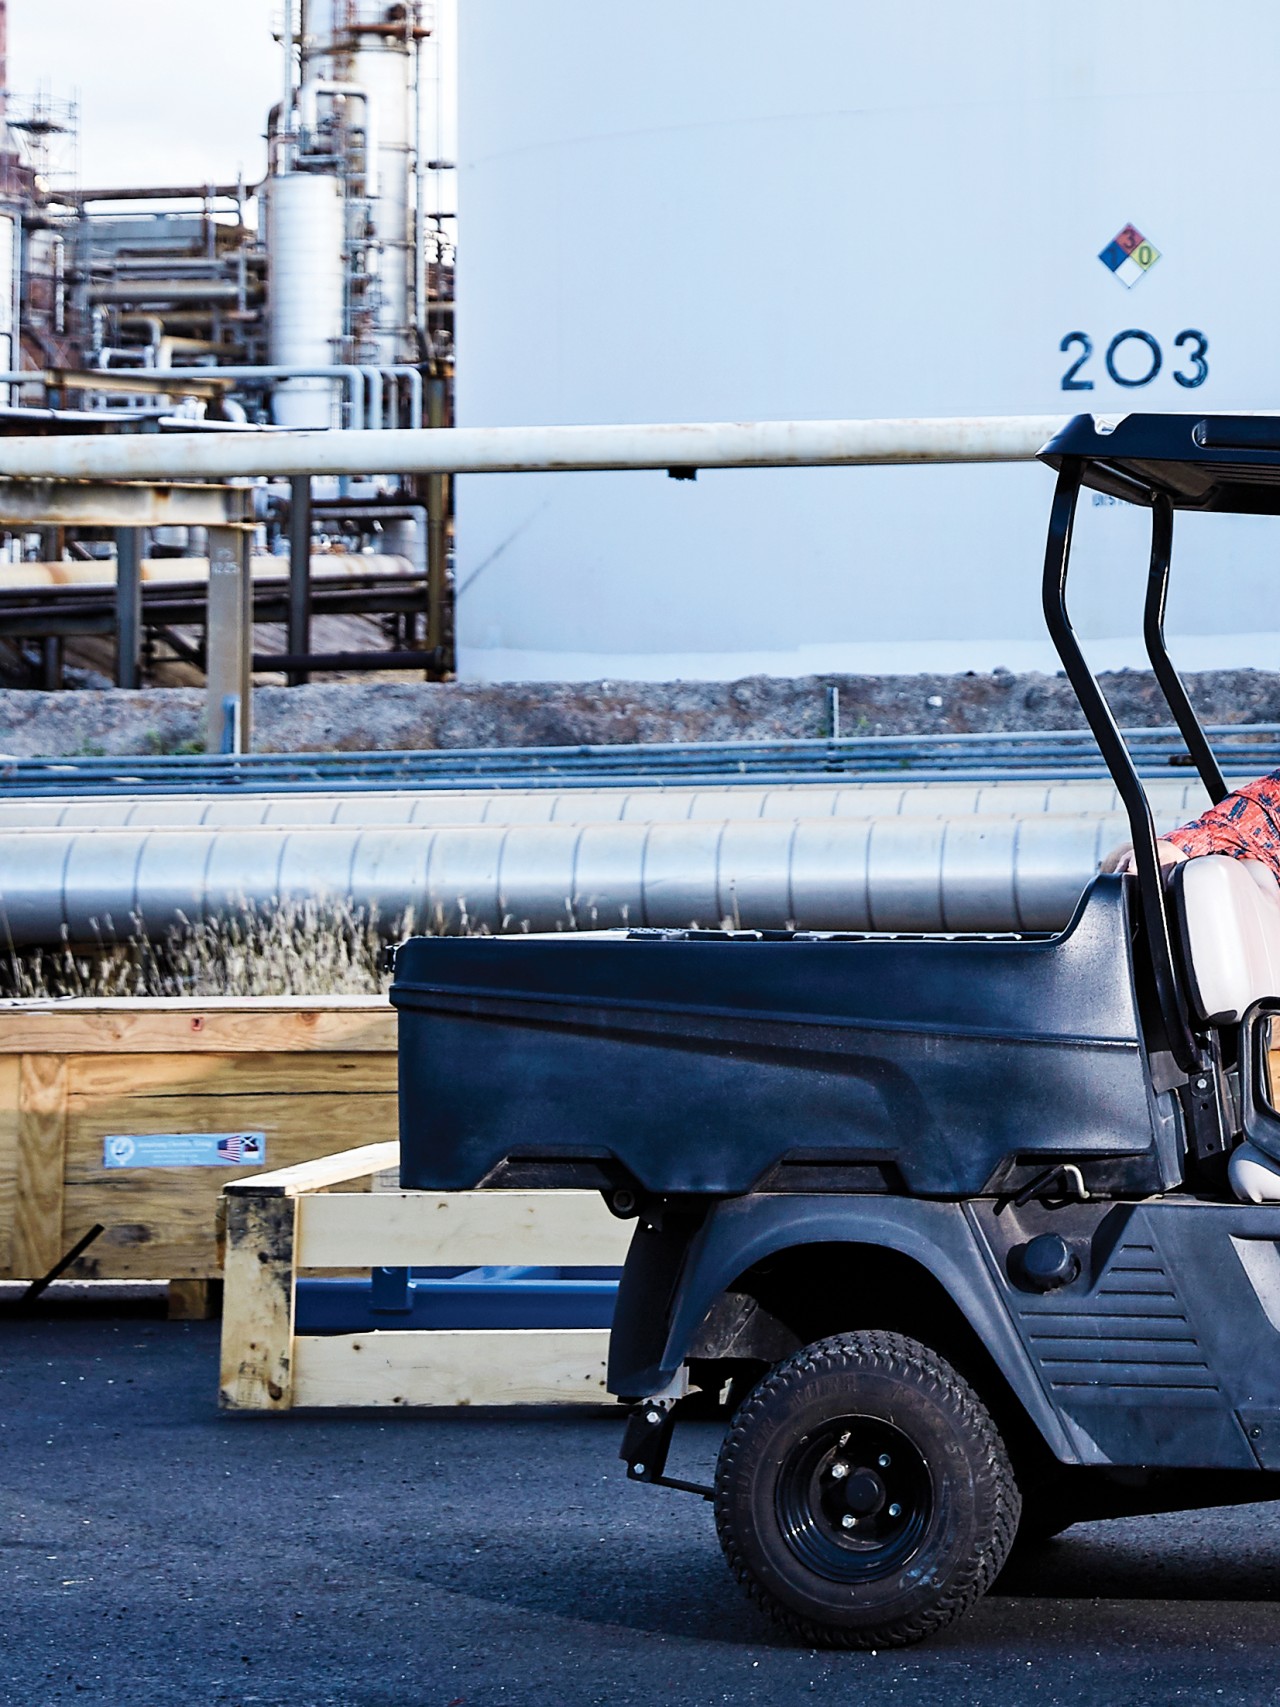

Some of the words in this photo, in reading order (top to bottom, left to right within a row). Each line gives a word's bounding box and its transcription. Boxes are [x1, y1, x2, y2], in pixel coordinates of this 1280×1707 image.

[1122, 228, 1136, 249] 3
[1138, 245, 1152, 266] 0
[1059, 328, 1208, 391] 203
